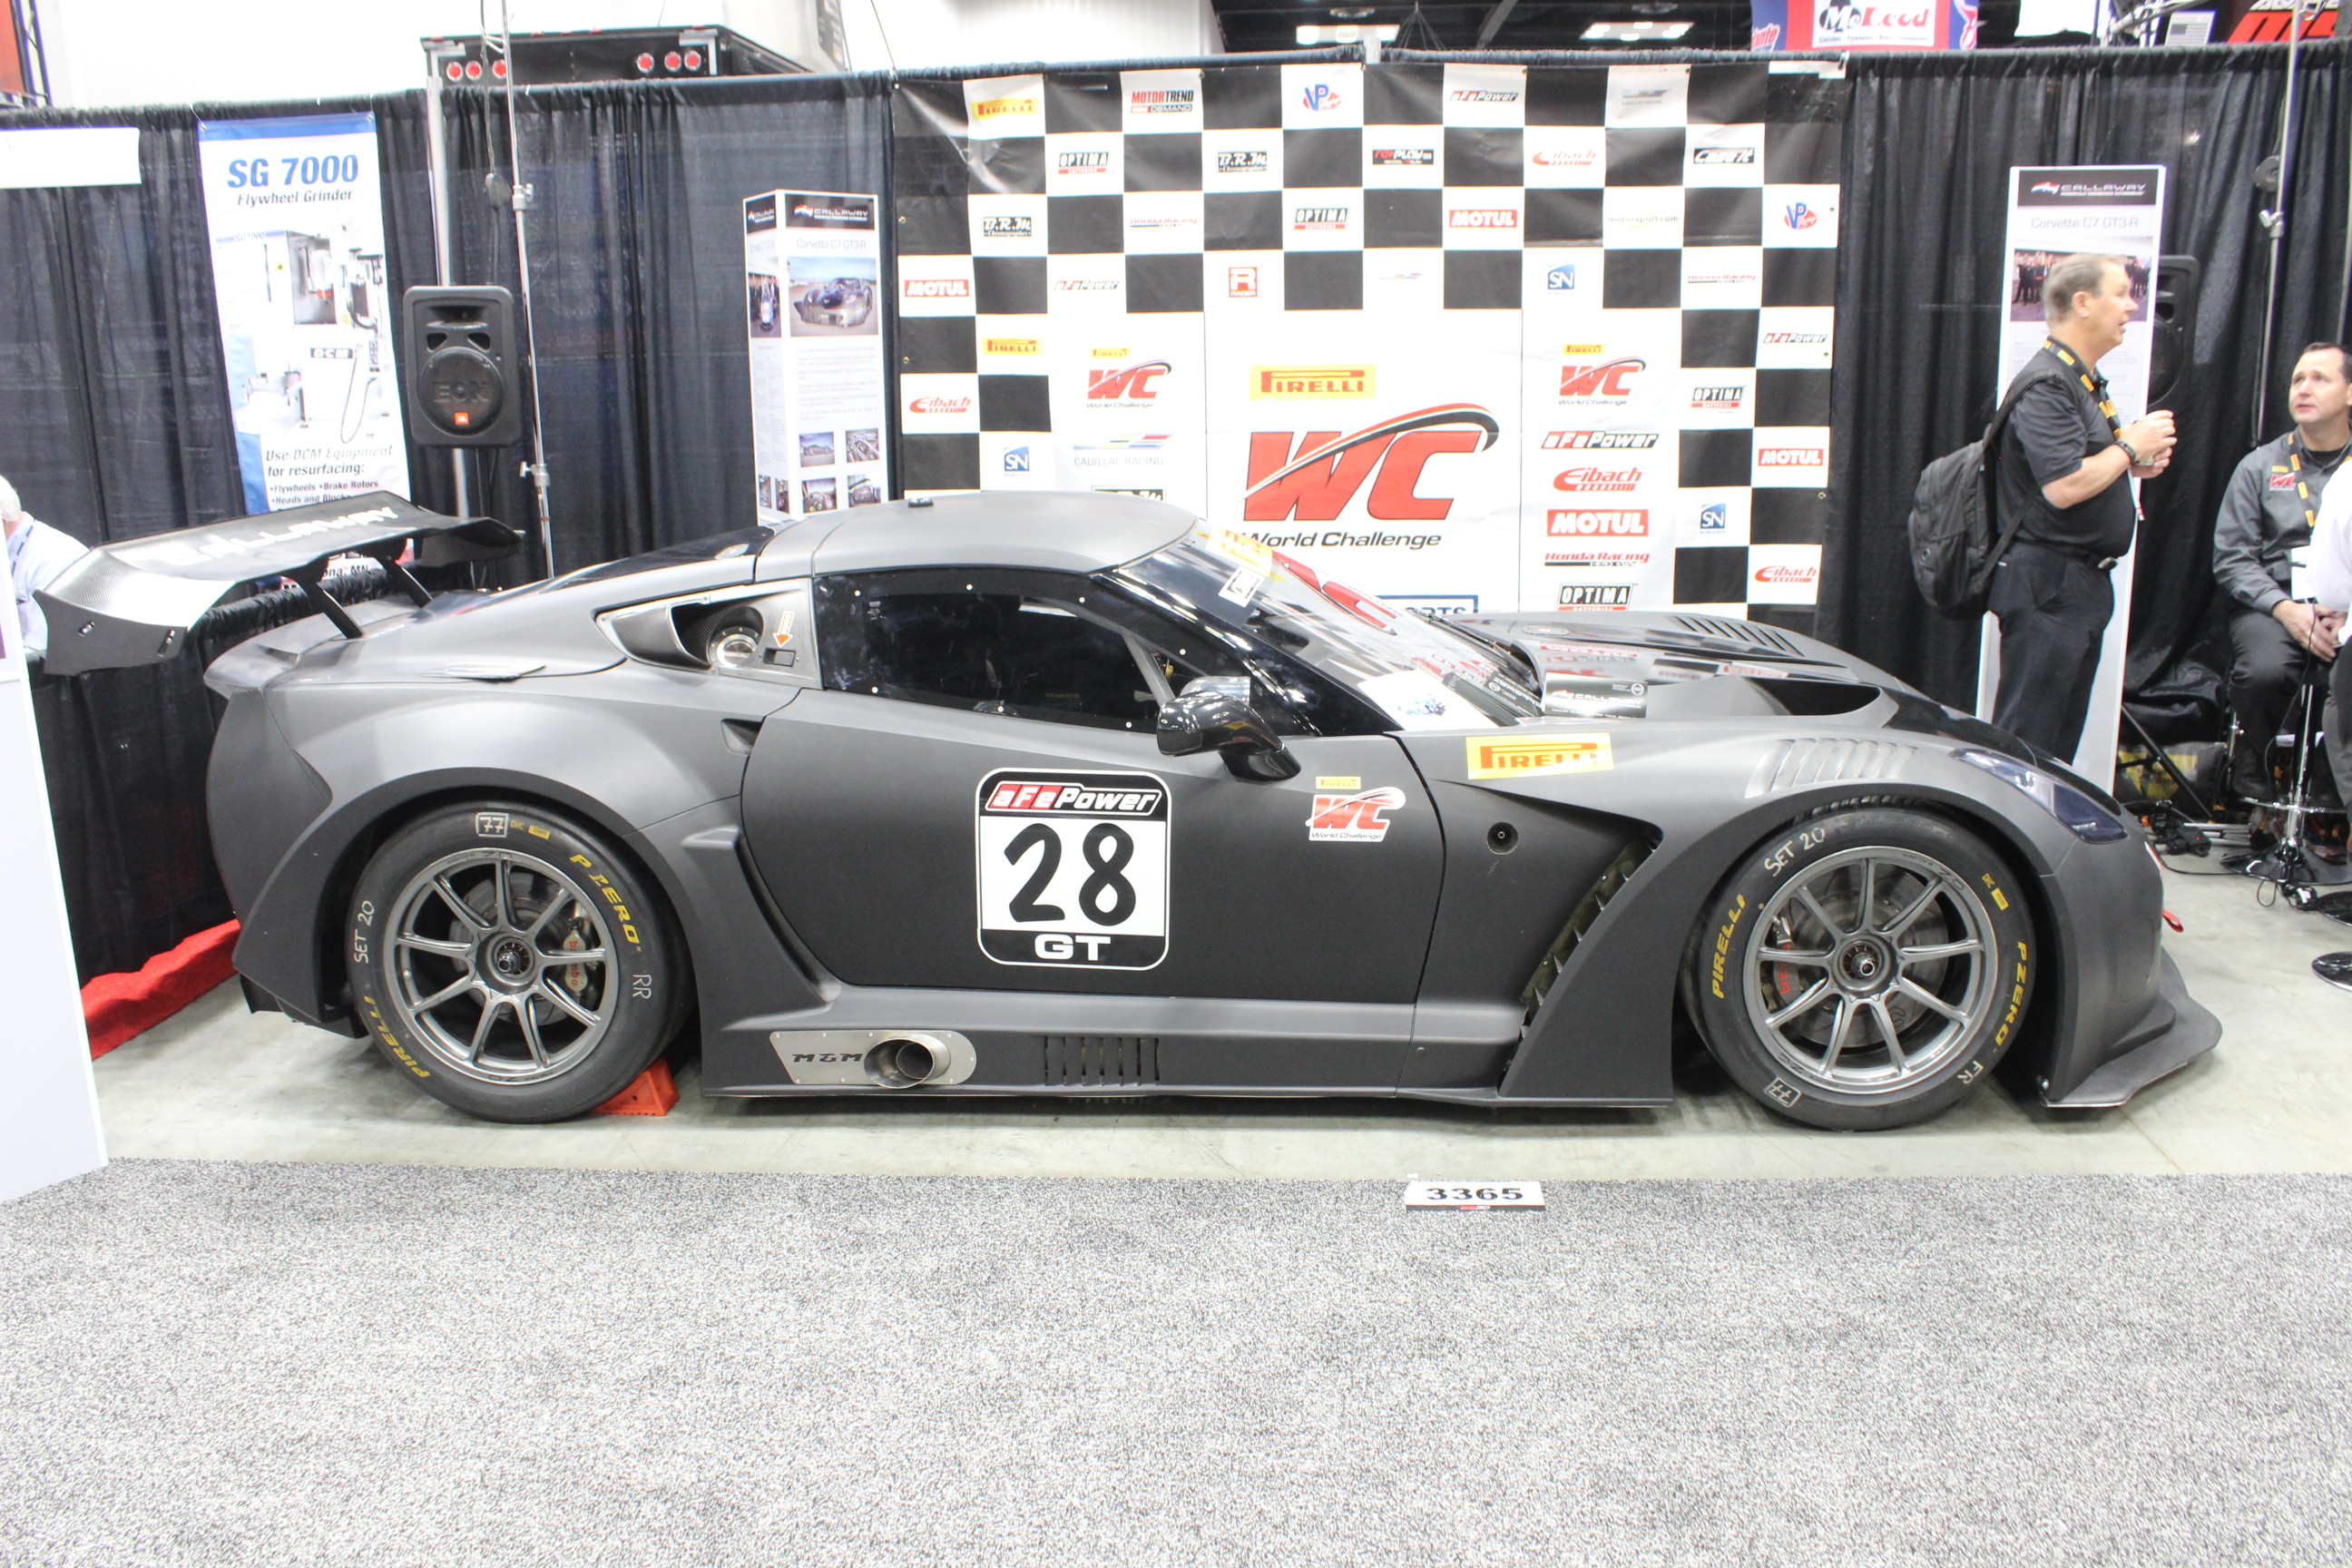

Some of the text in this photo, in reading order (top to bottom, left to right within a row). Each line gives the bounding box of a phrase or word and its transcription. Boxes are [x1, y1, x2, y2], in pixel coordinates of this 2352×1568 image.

[1819, 5, 1929, 33] McLeod
[1305, 83, 1328, 111] VP
[976, 99, 1033, 116] PIRELLI
[1151, 103, 1191, 113] DEMAND
[1060, 152, 1108, 167] OPTIMA
[227, 153, 359, 189] SG 7000
[2060, 183, 2147, 192] CALLAWAY
[237, 188, 355, 209] Flywheel Grinder
[813, 208, 868, 218] CALLAWAY
[1296, 208, 1348, 222] OPTIMA
[1451, 211, 1515, 227] MOTUL
[1786, 201, 1807, 230] VP
[2030, 217, 2139, 230] Corvette C7 GT3-R
[796, 238, 867, 251] Corvette C7 GT3-R
[906, 280, 967, 296] MOTUL
[1549, 271, 1574, 289] SN
[312, 348, 350, 359] DCM
[987, 339, 1036, 353] PIRELLI
[1093, 348, 1128, 358] PIRELLI
[1565, 345, 1602, 354] PIRELLI
[1088, 368, 1167, 399] WC
[1260, 369, 1366, 393] PIRELLI
[1559, 365, 1642, 397] WC
[1693, 387, 1742, 401] OPTIMA
[909, 396, 972, 413] Eibach
[266, 445, 394, 463] Use DCM Equipment
[1004, 454, 1029, 471] SN
[1759, 449, 1823, 466] MOTUL
[267, 462, 365, 478] for resurfacing:
[1243, 429, 1483, 522] WC
[1553, 466, 1642, 491] Eibach
[1551, 511, 1645, 534] MOTUL
[1701, 511, 1725, 528] SN
[1321, 531, 1442, 550] Challenge
[1544, 552, 1594, 562] Honda
[1595, 552, 1650, 564] Racing
[1755, 565, 1817, 583] Eibach
[1560, 586, 1629, 604] OPTIMA
[1574, 692, 1643, 706] CALLAWAY
[1480, 741, 1599, 769] PIRELLI
[1319, 779, 1357, 787] PIRELLI
[1312, 796, 1396, 830] WC
[1311, 832, 1382, 841] World Challenge
[1763, 827, 1826, 877] SET 20
[1004, 822, 1137, 927] 28
[354, 899, 376, 965] SET 20
[1034, 933, 1112, 962] GT
[1711, 893, 1747, 999] PIRELLI
[632, 974, 653, 1000] RR
[363, 995, 431, 1078] PIRELLI
[1956, 1060, 1985, 1085] FR
[1426, 1187, 1524, 1200] 3365
